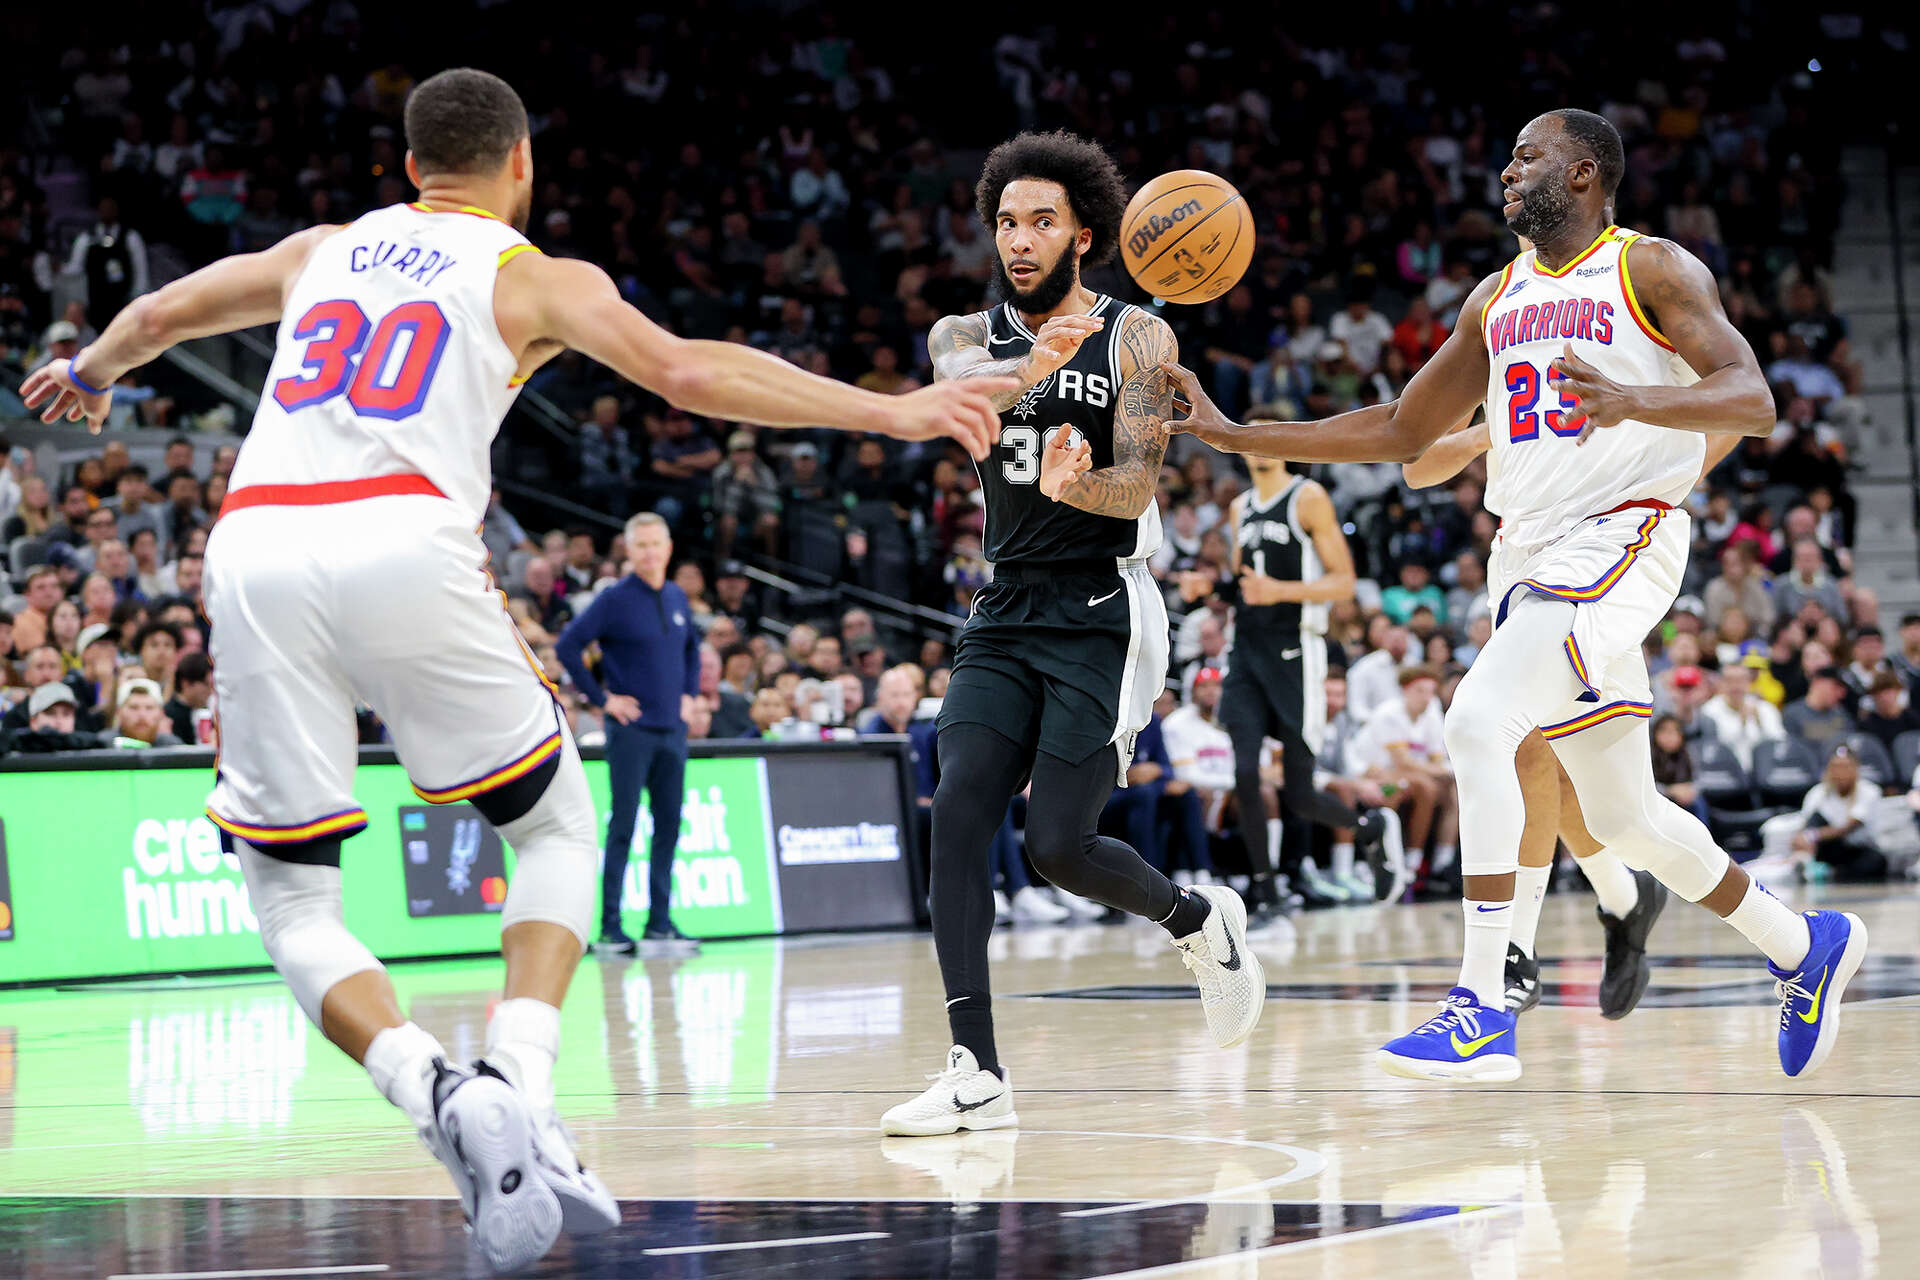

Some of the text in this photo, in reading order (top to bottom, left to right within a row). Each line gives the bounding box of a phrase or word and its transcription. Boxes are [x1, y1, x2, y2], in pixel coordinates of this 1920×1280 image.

[1128, 198, 1203, 258] Wilson
[351, 240, 456, 287] CURRY
[1490, 298, 1614, 358] WARRIORS
[273, 299, 451, 421] 30
[123, 867, 261, 938] hum
